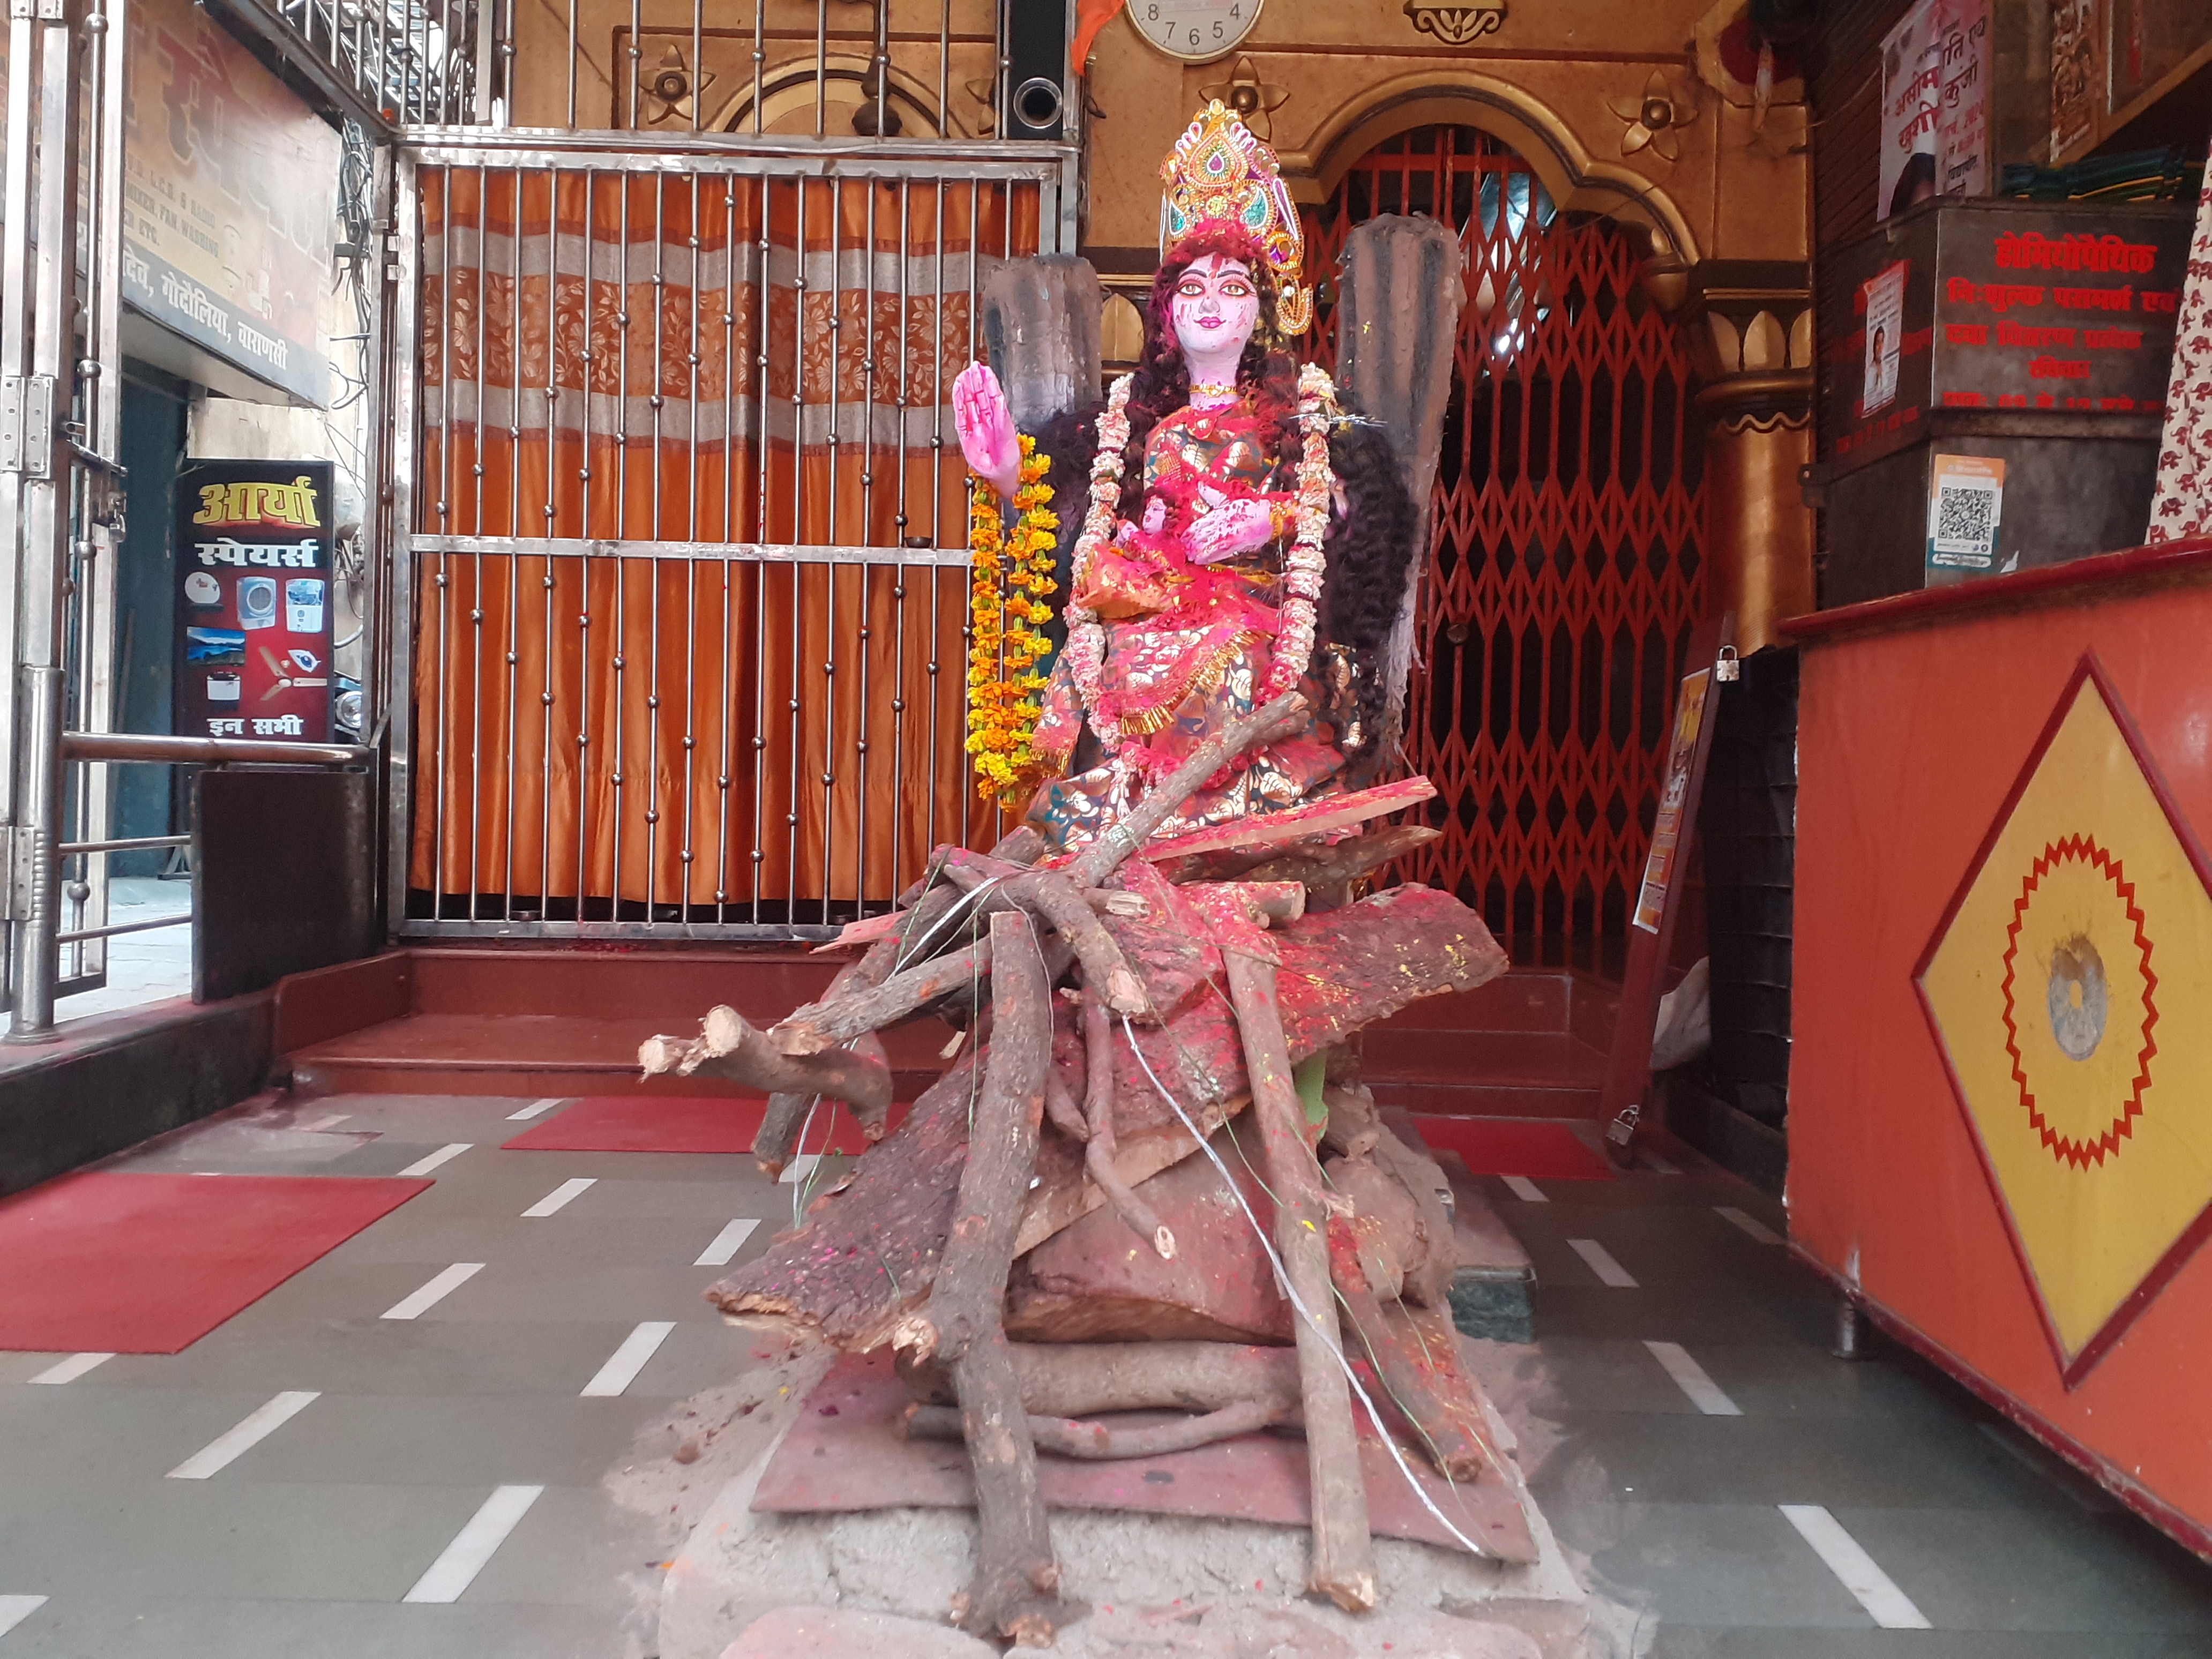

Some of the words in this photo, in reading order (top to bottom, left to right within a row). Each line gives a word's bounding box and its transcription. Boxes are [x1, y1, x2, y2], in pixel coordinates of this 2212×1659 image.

[1148, 4, 1159, 21] 8
[1229, 4, 1240, 20] 4
[1165, 21, 1176, 39] 7
[1189, 28, 1200, 46] 6
[1212, 21, 1223, 39] 5
[238, 320, 288, 370] वाराणसी
[192, 475, 321, 528] आर्या
[194, 537, 319, 567] स्पेयर्स
[206, 718, 245, 736] इन
[251, 714, 304, 735] सभी
